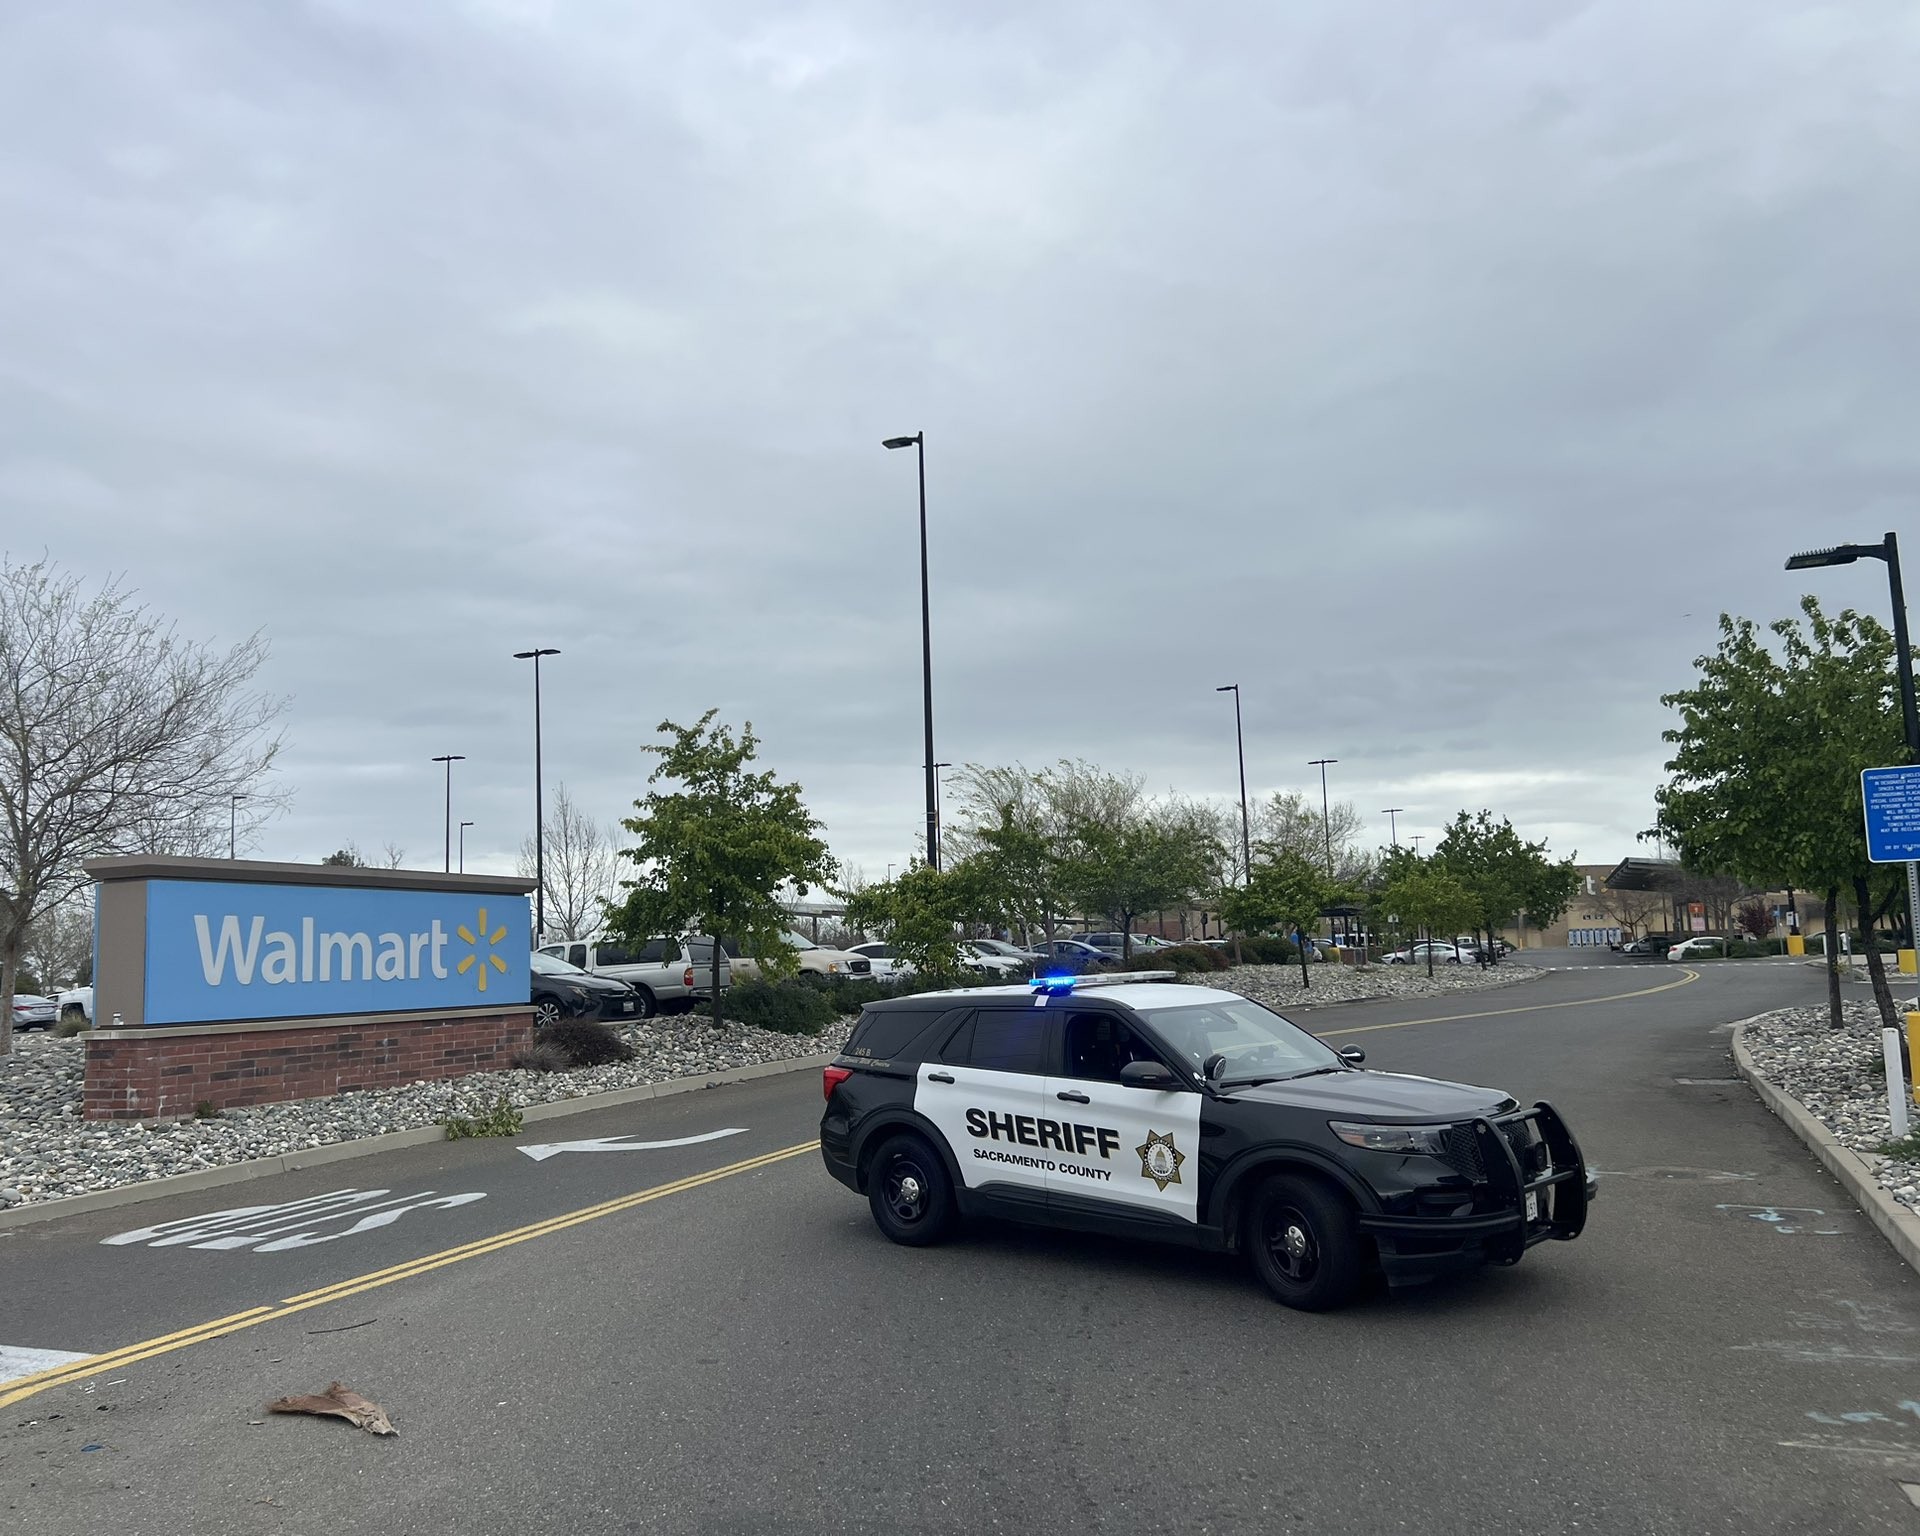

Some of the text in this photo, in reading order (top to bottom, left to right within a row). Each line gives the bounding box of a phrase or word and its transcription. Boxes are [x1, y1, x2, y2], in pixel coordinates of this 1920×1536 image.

[193, 914, 448, 987] Walmart
[965, 1107, 1121, 1160] SHERIFF
[973, 1148, 1112, 1182] SACRAMENTO COUNTY
[98, 1187, 489, 1253] STOP
